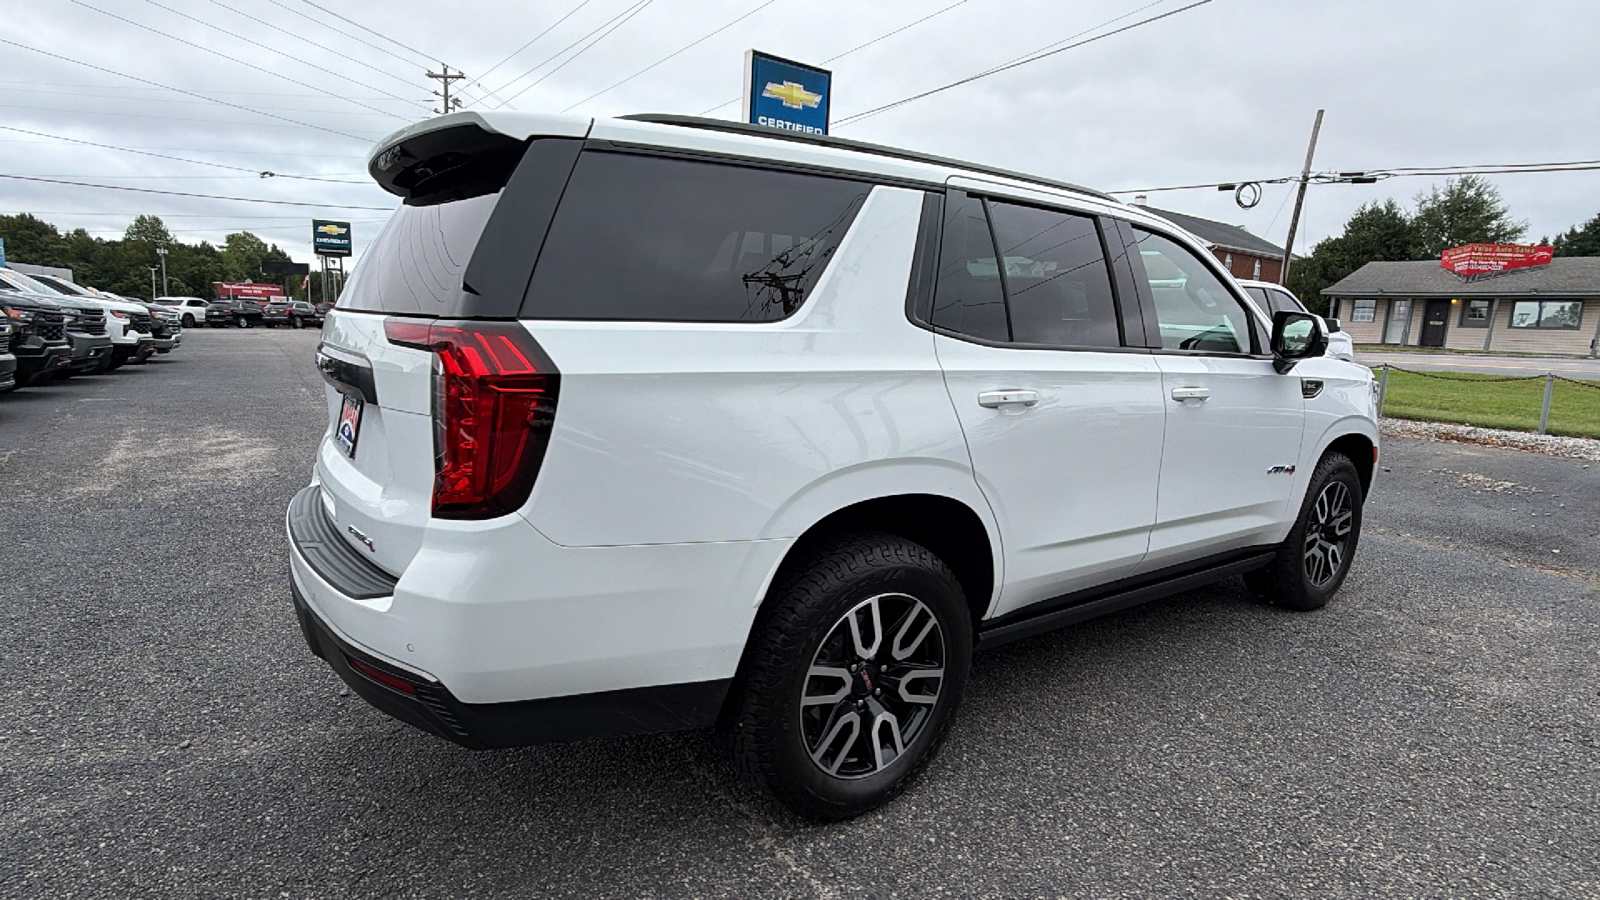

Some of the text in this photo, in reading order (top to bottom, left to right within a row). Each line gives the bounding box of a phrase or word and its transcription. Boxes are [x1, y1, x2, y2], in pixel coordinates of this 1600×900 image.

[758, 116, 823, 136] CERTIFIED
[1495, 245, 1512, 253] Auto
[1515, 246, 1535, 254] Sales
